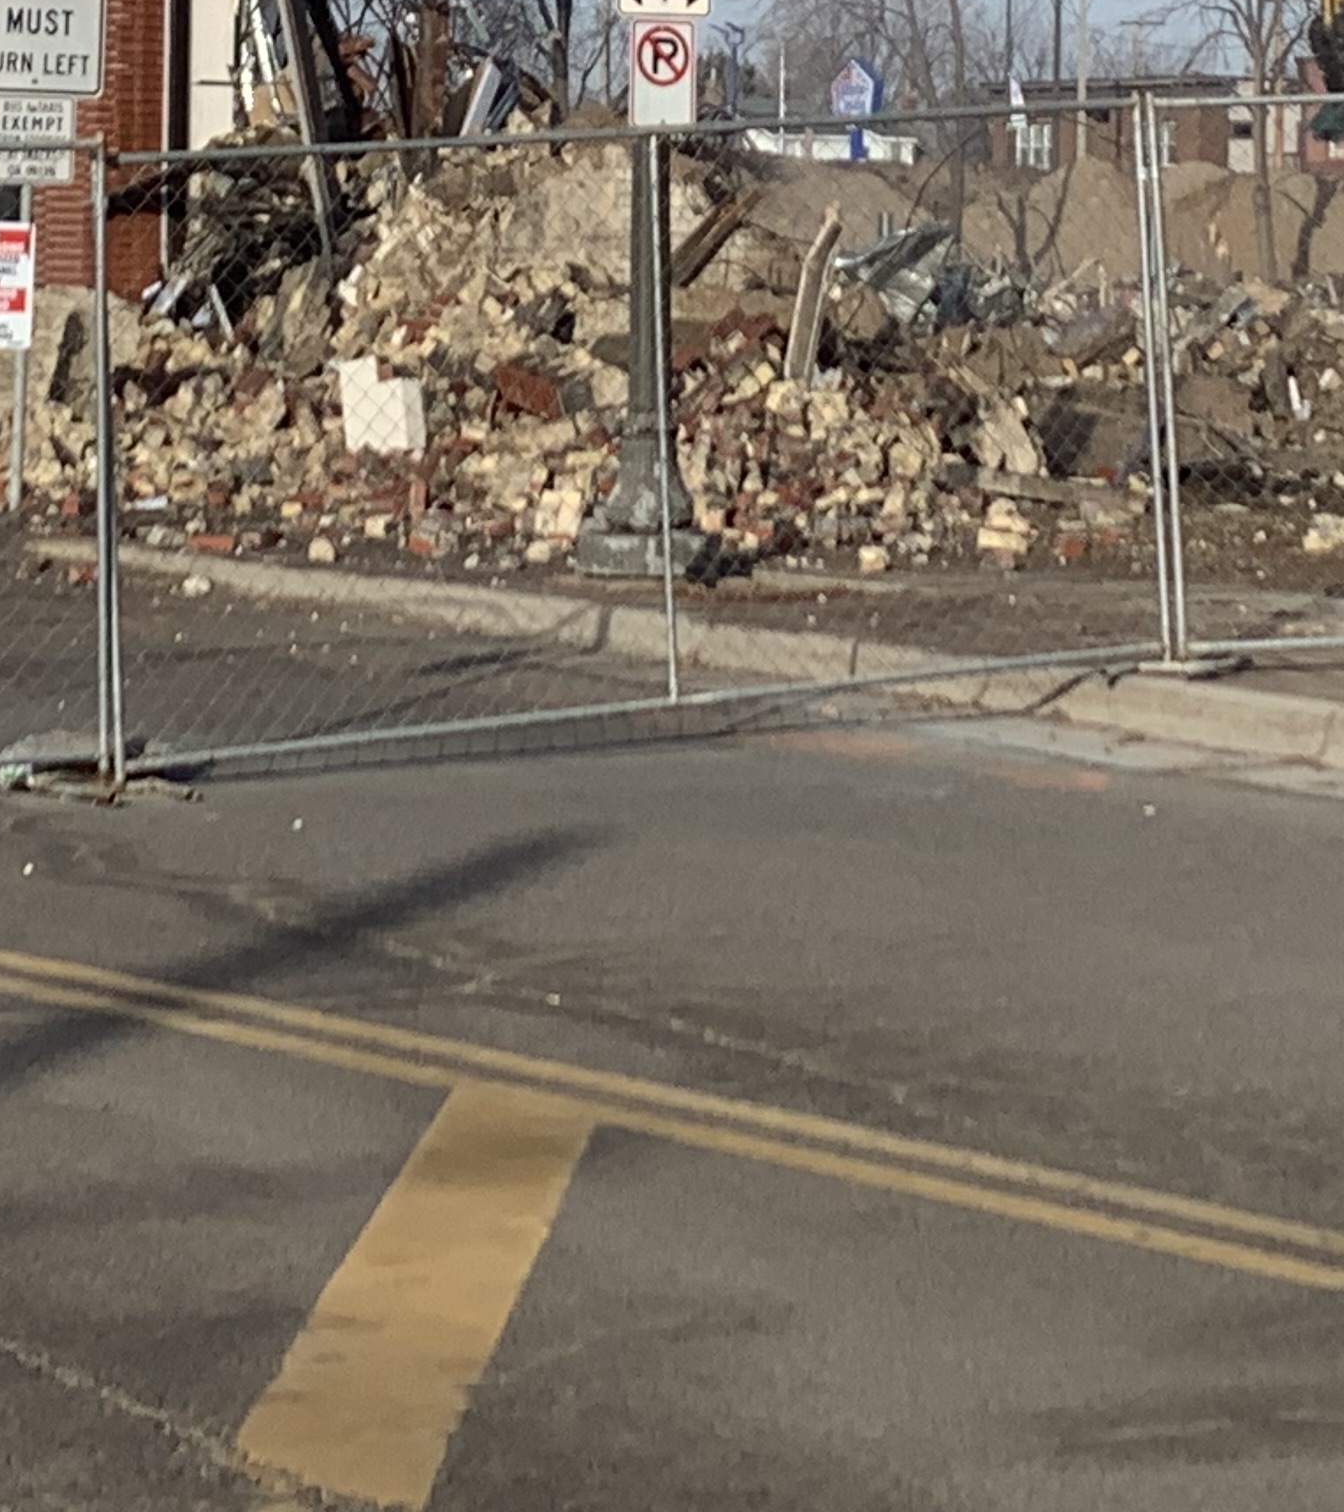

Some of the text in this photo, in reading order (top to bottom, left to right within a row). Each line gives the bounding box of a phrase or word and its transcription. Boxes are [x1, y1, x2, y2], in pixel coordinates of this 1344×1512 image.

[6, 7, 74, 36] MUST
[42, 53, 90, 76] LEFT
[1, 115, 64, 131] EXEMPT
